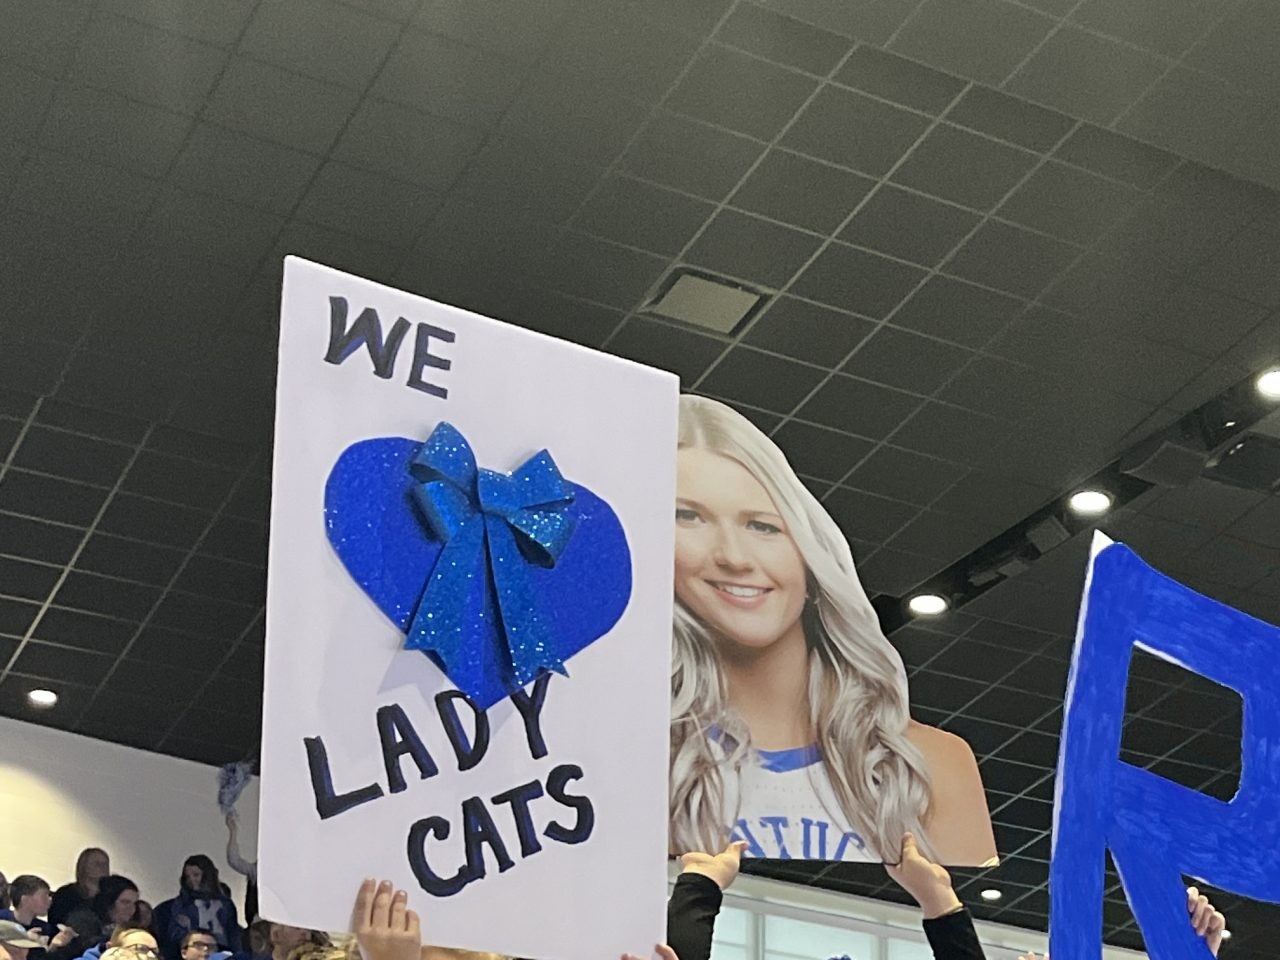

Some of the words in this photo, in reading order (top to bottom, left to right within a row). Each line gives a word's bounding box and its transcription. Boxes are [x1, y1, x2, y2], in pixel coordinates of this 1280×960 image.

[324, 296, 456, 400] WE
[303, 672, 552, 821] LADY
[406, 763, 595, 897] CATS
